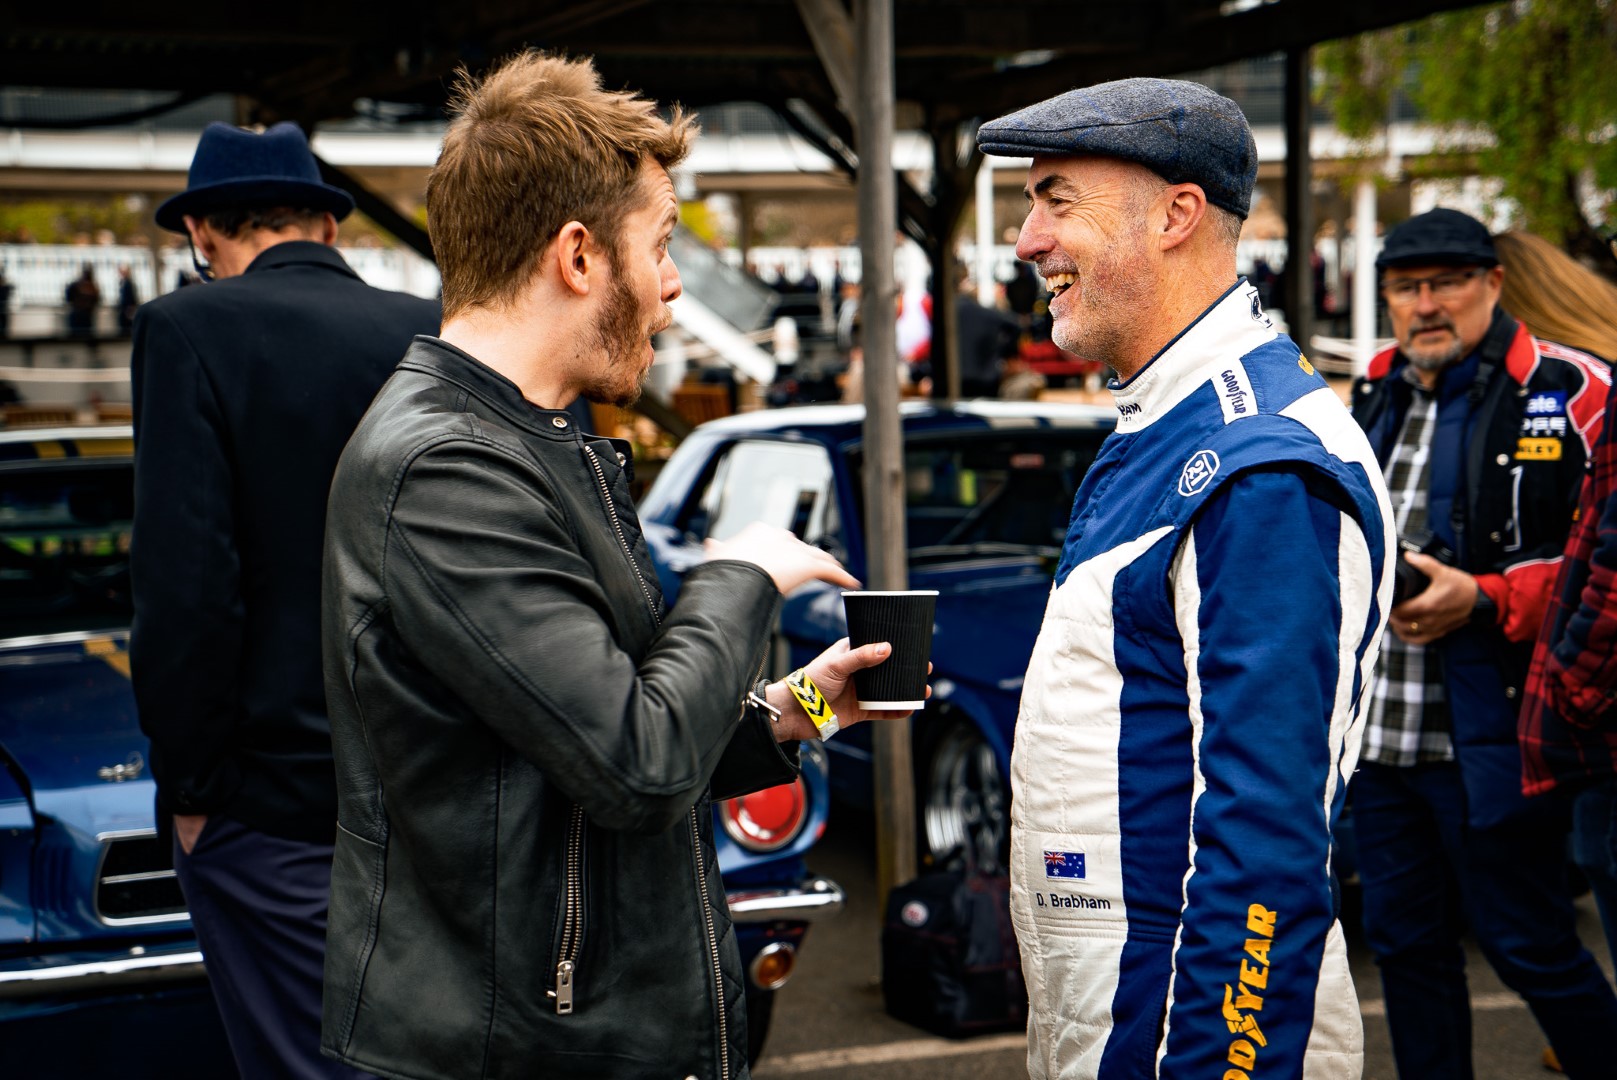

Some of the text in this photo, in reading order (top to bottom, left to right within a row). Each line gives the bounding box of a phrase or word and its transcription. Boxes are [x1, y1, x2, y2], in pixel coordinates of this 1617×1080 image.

[1221, 369, 1247, 414] GOODYEAR
[1187, 459, 1209, 487] 21
[1036, 892, 1111, 910] D. Brabham
